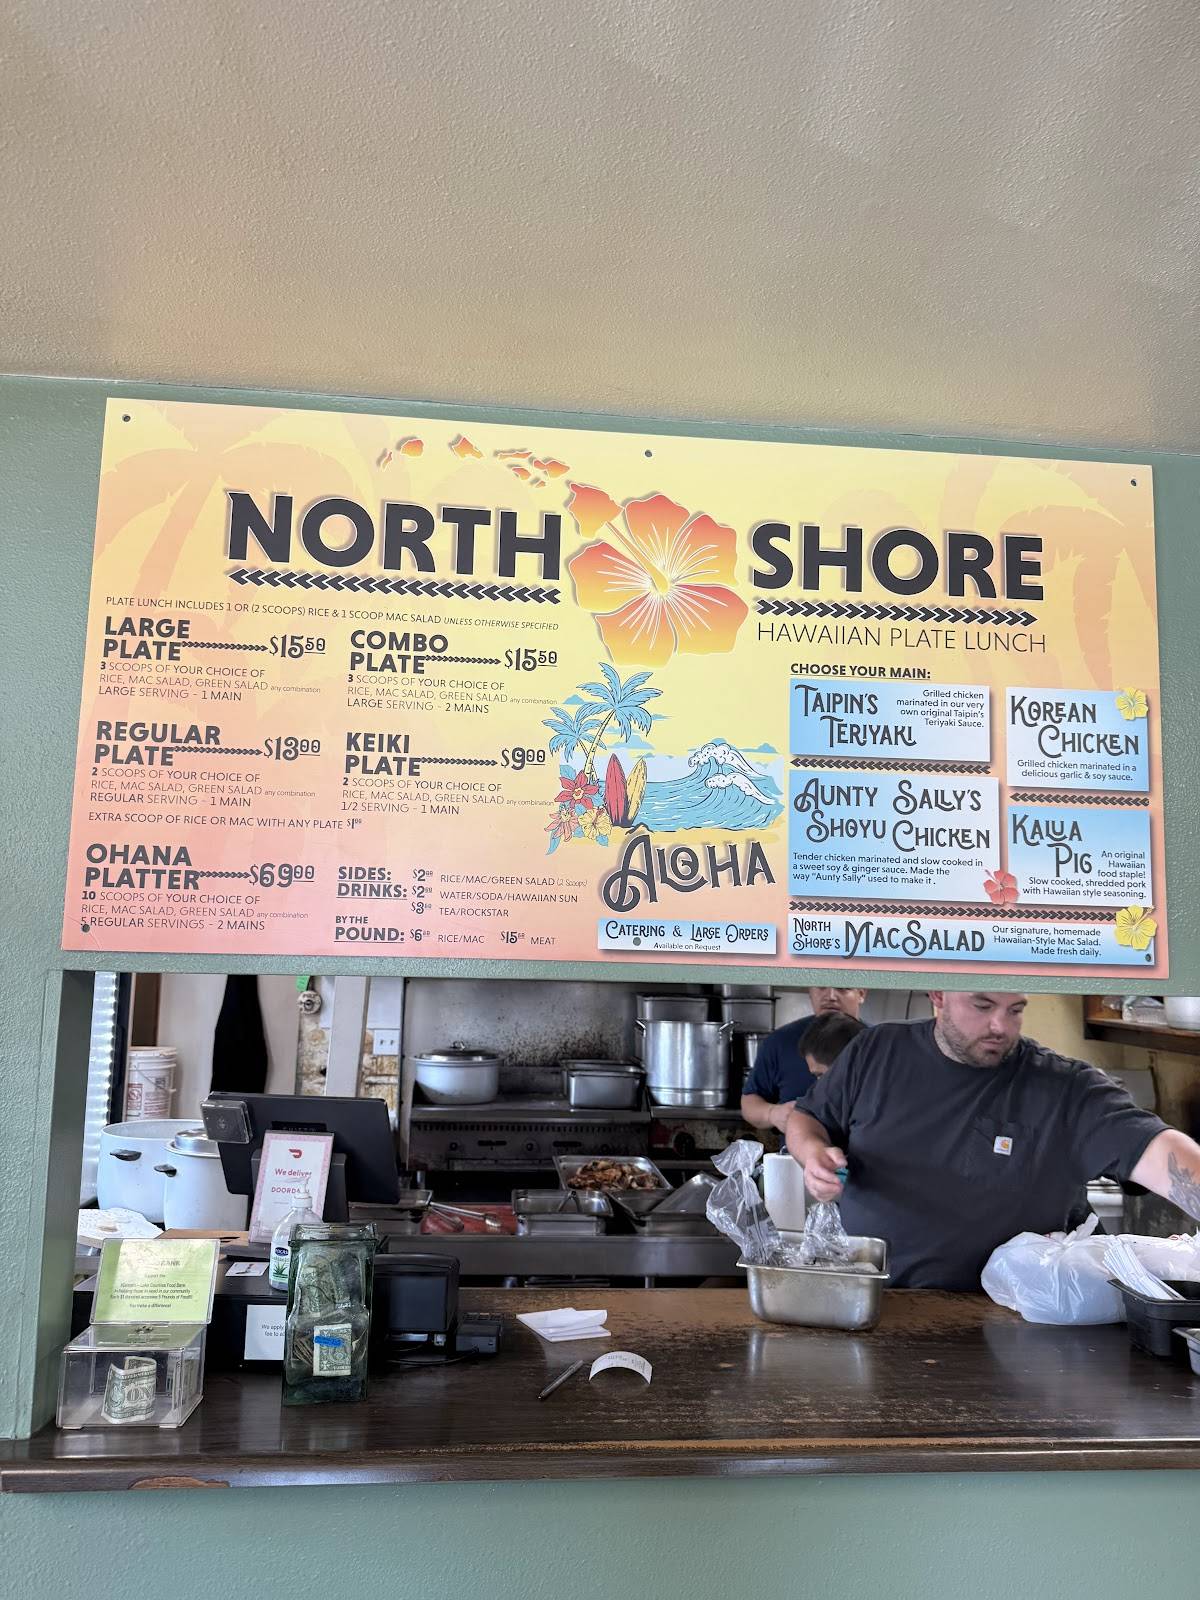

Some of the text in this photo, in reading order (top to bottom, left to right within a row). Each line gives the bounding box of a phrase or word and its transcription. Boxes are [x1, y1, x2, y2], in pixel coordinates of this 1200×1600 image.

[226, 491, 1044, 600] NORTH SHORE
[105, 596, 559, 630] PLATE LUNCH INCLUDES 1 OR (2 SCOOPS) RICE & 1 SCOOP MAC SALAD UNLESS OTHERWISE SPECIFIED
[105, 616, 190, 639] LARGE
[351, 630, 448, 653] COMBO
[758, 622, 1046, 653] HAWAIIAN PLATE LUNCH
[103, 639, 181, 661] PLATE
[100, 661, 266, 678] 3 SCOOPS OF YOUR CHOICE OF
[350, 652, 425, 674] PLATE
[791, 663, 931, 679] CHOOSE YOUR MAIN:
[98, 686, 241, 701] LARGE SERVING 1 MAIN
[346, 686, 508, 702] RICE, MAC SALAD, GREEN SALAD
[922, 689, 983, 699] Grilled chicken
[920, 709, 952, 718] original
[953, 709, 984, 719] Taipin's
[965, 702, 984, 710] very
[924, 718, 984, 727] Teriyaki Sauce.
[96, 721, 220, 745] REGULAR
[346, 732, 410, 753] KEIKI
[94, 744, 173, 766] PLATE
[345, 755, 421, 776] PLATE
[1017, 759, 1046, 767] Grilled
[1046, 760, 1078, 769] chicken
[1079, 761, 1121, 770] marinated
[1122, 763, 1131, 771] in
[1021, 769, 1058, 778] delicious
[1059, 770, 1082, 780] garlic
[1083, 771, 1091, 779] &
[1092, 773, 1107, 781] soy
[89, 792, 250, 807] REGULAR SERVING 1 MAIN
[88, 812, 343, 829] EXTRA SCOOP OF RICE OR MAC WITH ANY PLATE
[86, 843, 192, 867] OHANA
[1100, 850, 1145, 861] An original
[1108, 860, 1145, 868] Hawaiian
[85, 867, 199, 890] PLATTER
[338, 867, 391, 882] SIDES:
[524, 877, 555, 885] SALAD
[603, 834, 776, 913] ALOHA
[1097, 869, 1146, 880] food staple!
[1028, 877, 1146, 889] Slow cooked, shredded pork
[338, 883, 407, 899] DRINKS:
[558, 894, 577, 902] SUN
[1022, 886, 1146, 899] with Hawaiian style seasoning.
[335, 915, 368, 924] BY THE
[793, 918, 831, 936] NORTH
[335, 927, 404, 942] POUND:
[530, 936, 556, 945] MEAT
[672, 925, 683, 937] &
[690, 924, 720, 941] LARGE
[991, 925, 1101, 937] Our signature, homemade
[993, 935, 1101, 948] Hawaiian-Style Mac Salad.
[1031, 946, 1101, 957] Made fresh daily.
